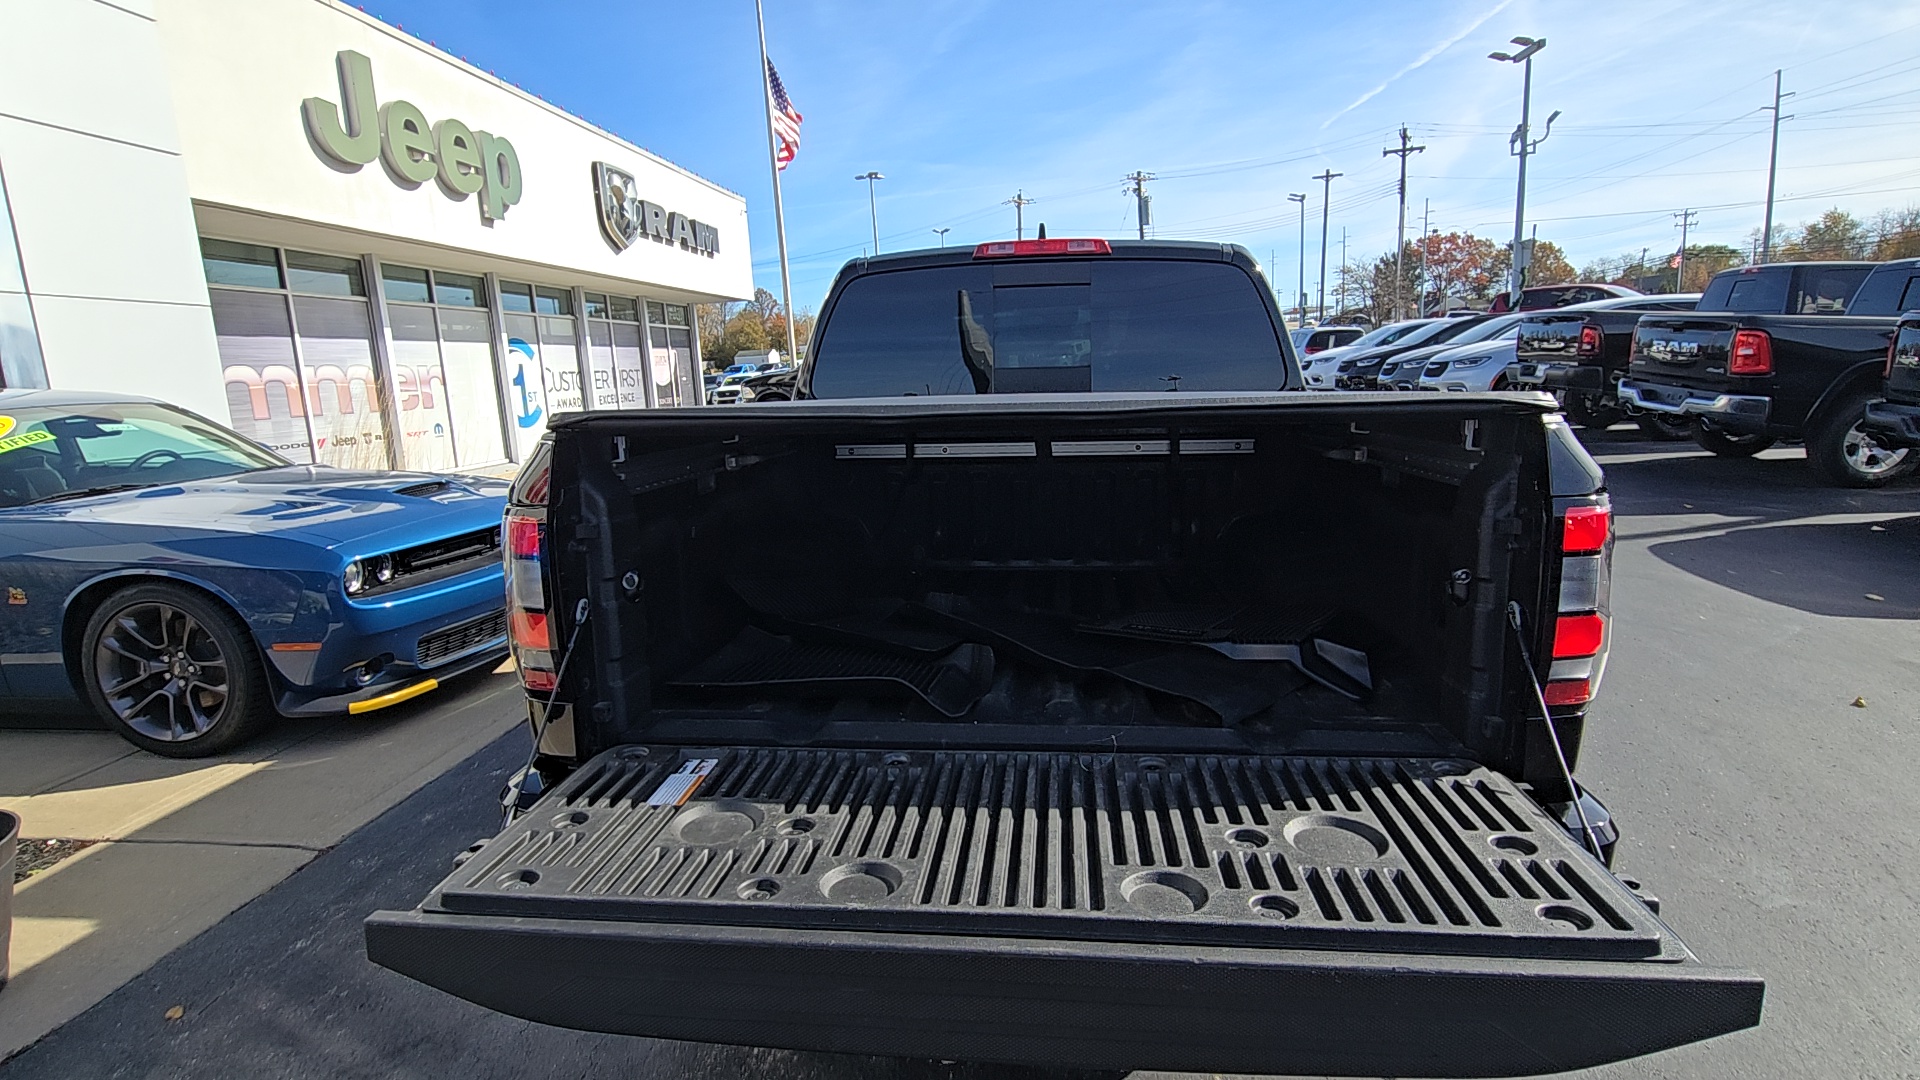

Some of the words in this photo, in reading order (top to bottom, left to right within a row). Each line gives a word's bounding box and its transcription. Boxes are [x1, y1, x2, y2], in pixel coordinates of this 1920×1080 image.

[301, 50, 522, 223] Jeep
[638, 199, 720, 255] RAM
[1651, 340, 1699, 354] RAM
[545, 367, 610, 393] USTOER
[556, 397, 583, 409] AWARD
[598, 392, 636, 406] EXCELENCE
[270, 442, 311, 451] DODG
[331, 434, 357, 447] Jeep
